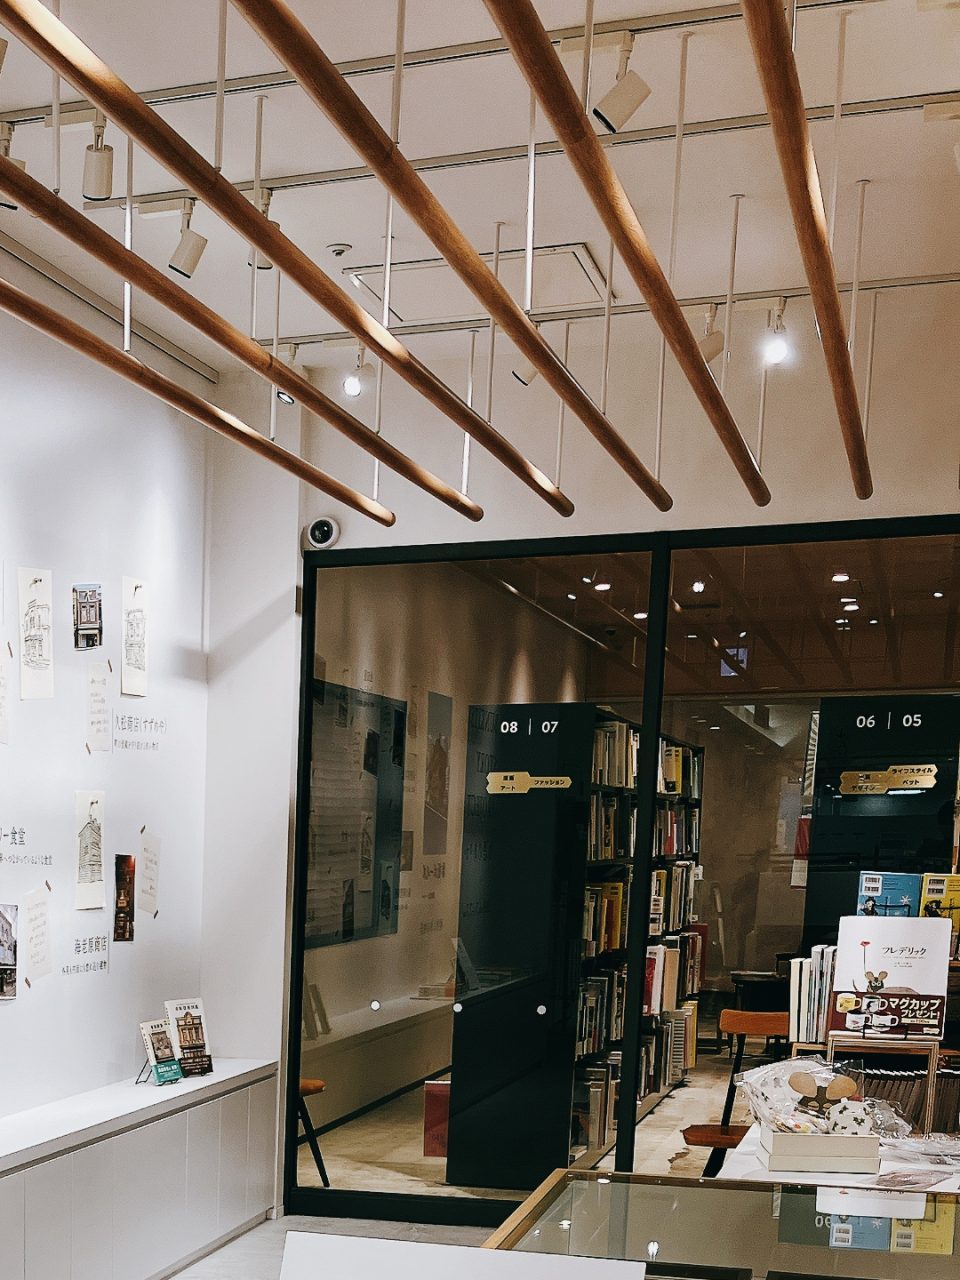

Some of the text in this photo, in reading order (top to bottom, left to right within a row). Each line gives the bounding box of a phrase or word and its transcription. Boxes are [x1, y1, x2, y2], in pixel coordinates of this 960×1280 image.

[856, 713, 922, 728] 06 05
[500, 721, 559, 733] 08 07
[882, 946, 927, 956] フレデリック
[889, 997, 941, 1010] マグカップ
